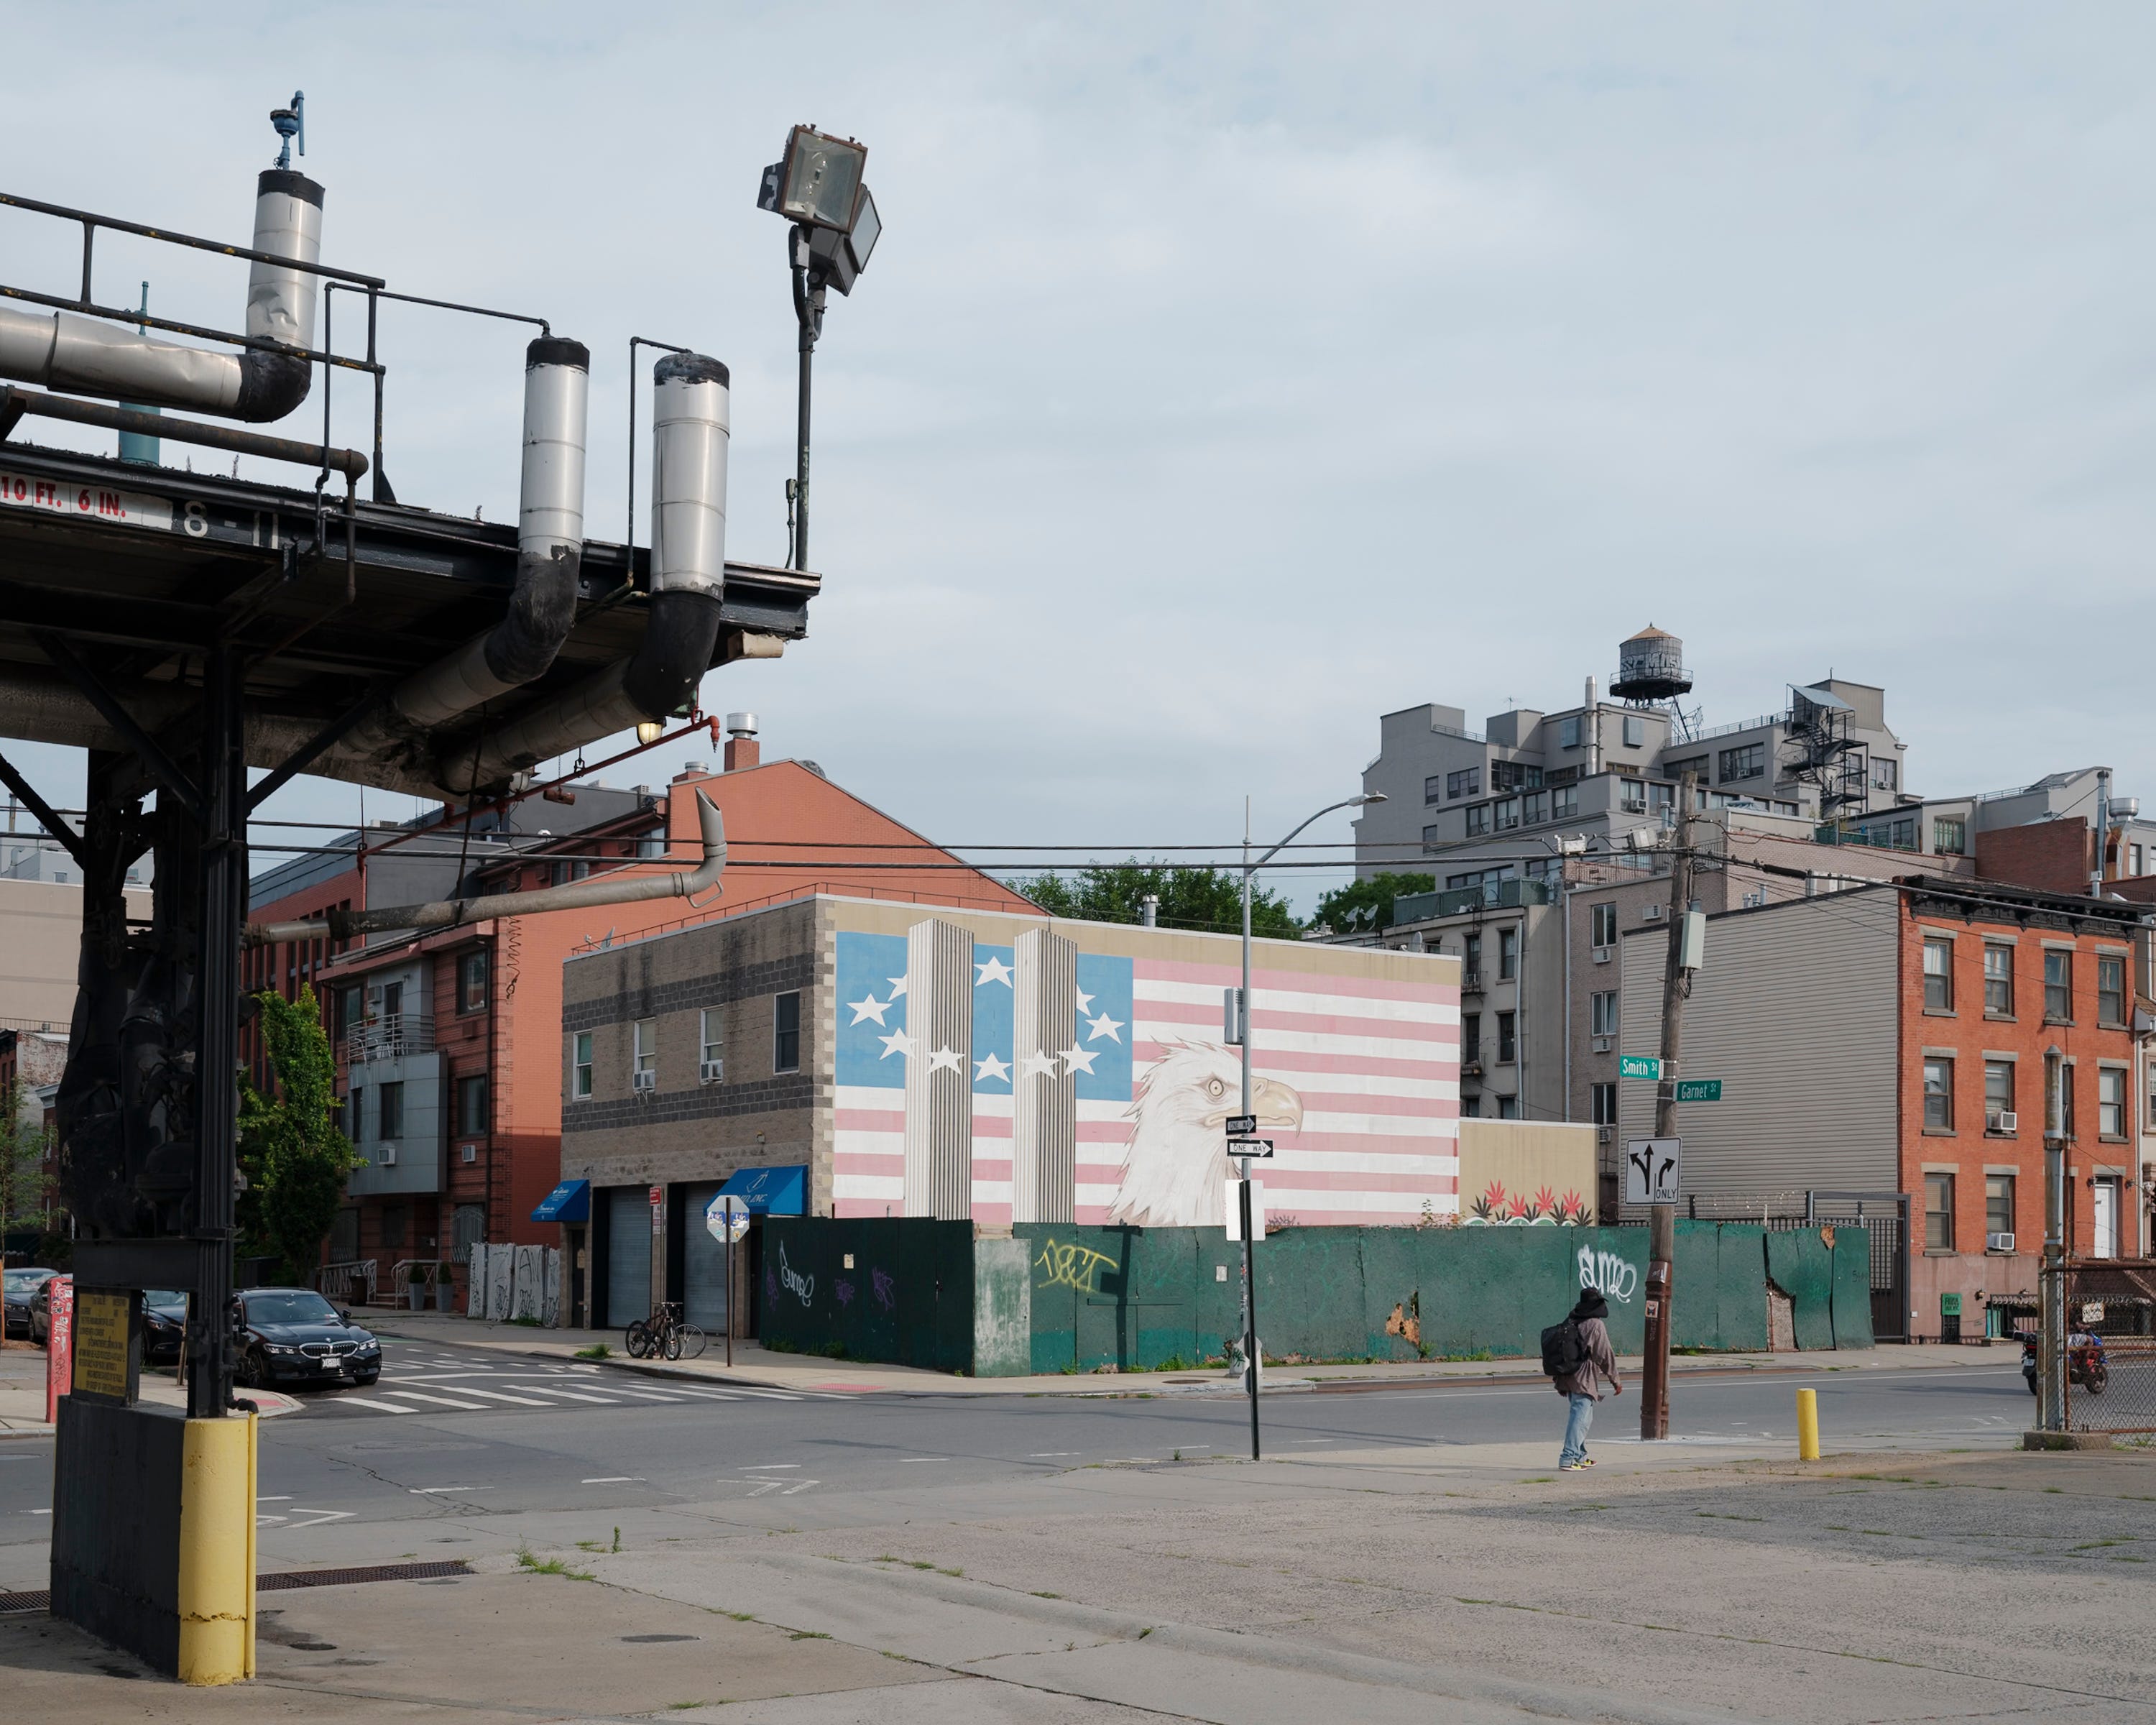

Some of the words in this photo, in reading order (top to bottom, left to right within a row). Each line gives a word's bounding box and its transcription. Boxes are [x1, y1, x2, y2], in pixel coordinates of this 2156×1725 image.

[1, 476, 27, 502] 10
[35, 481, 63, 507] FT.
[78, 488, 91, 511] 6
[98, 491, 126, 518] IN.
[1622, 1058, 1649, 1076] Smith
[1651, 1062, 1658, 1072] St
[1681, 1083, 1708, 1100] Garnet
[1710, 1082, 1717, 1092] St
[1229, 1121, 1239, 1130] ONE
[1243, 1120, 1252, 1128] WAY
[1253, 1144, 1267, 1153] WAY
[1655, 1188, 1677, 1200] ONLY
